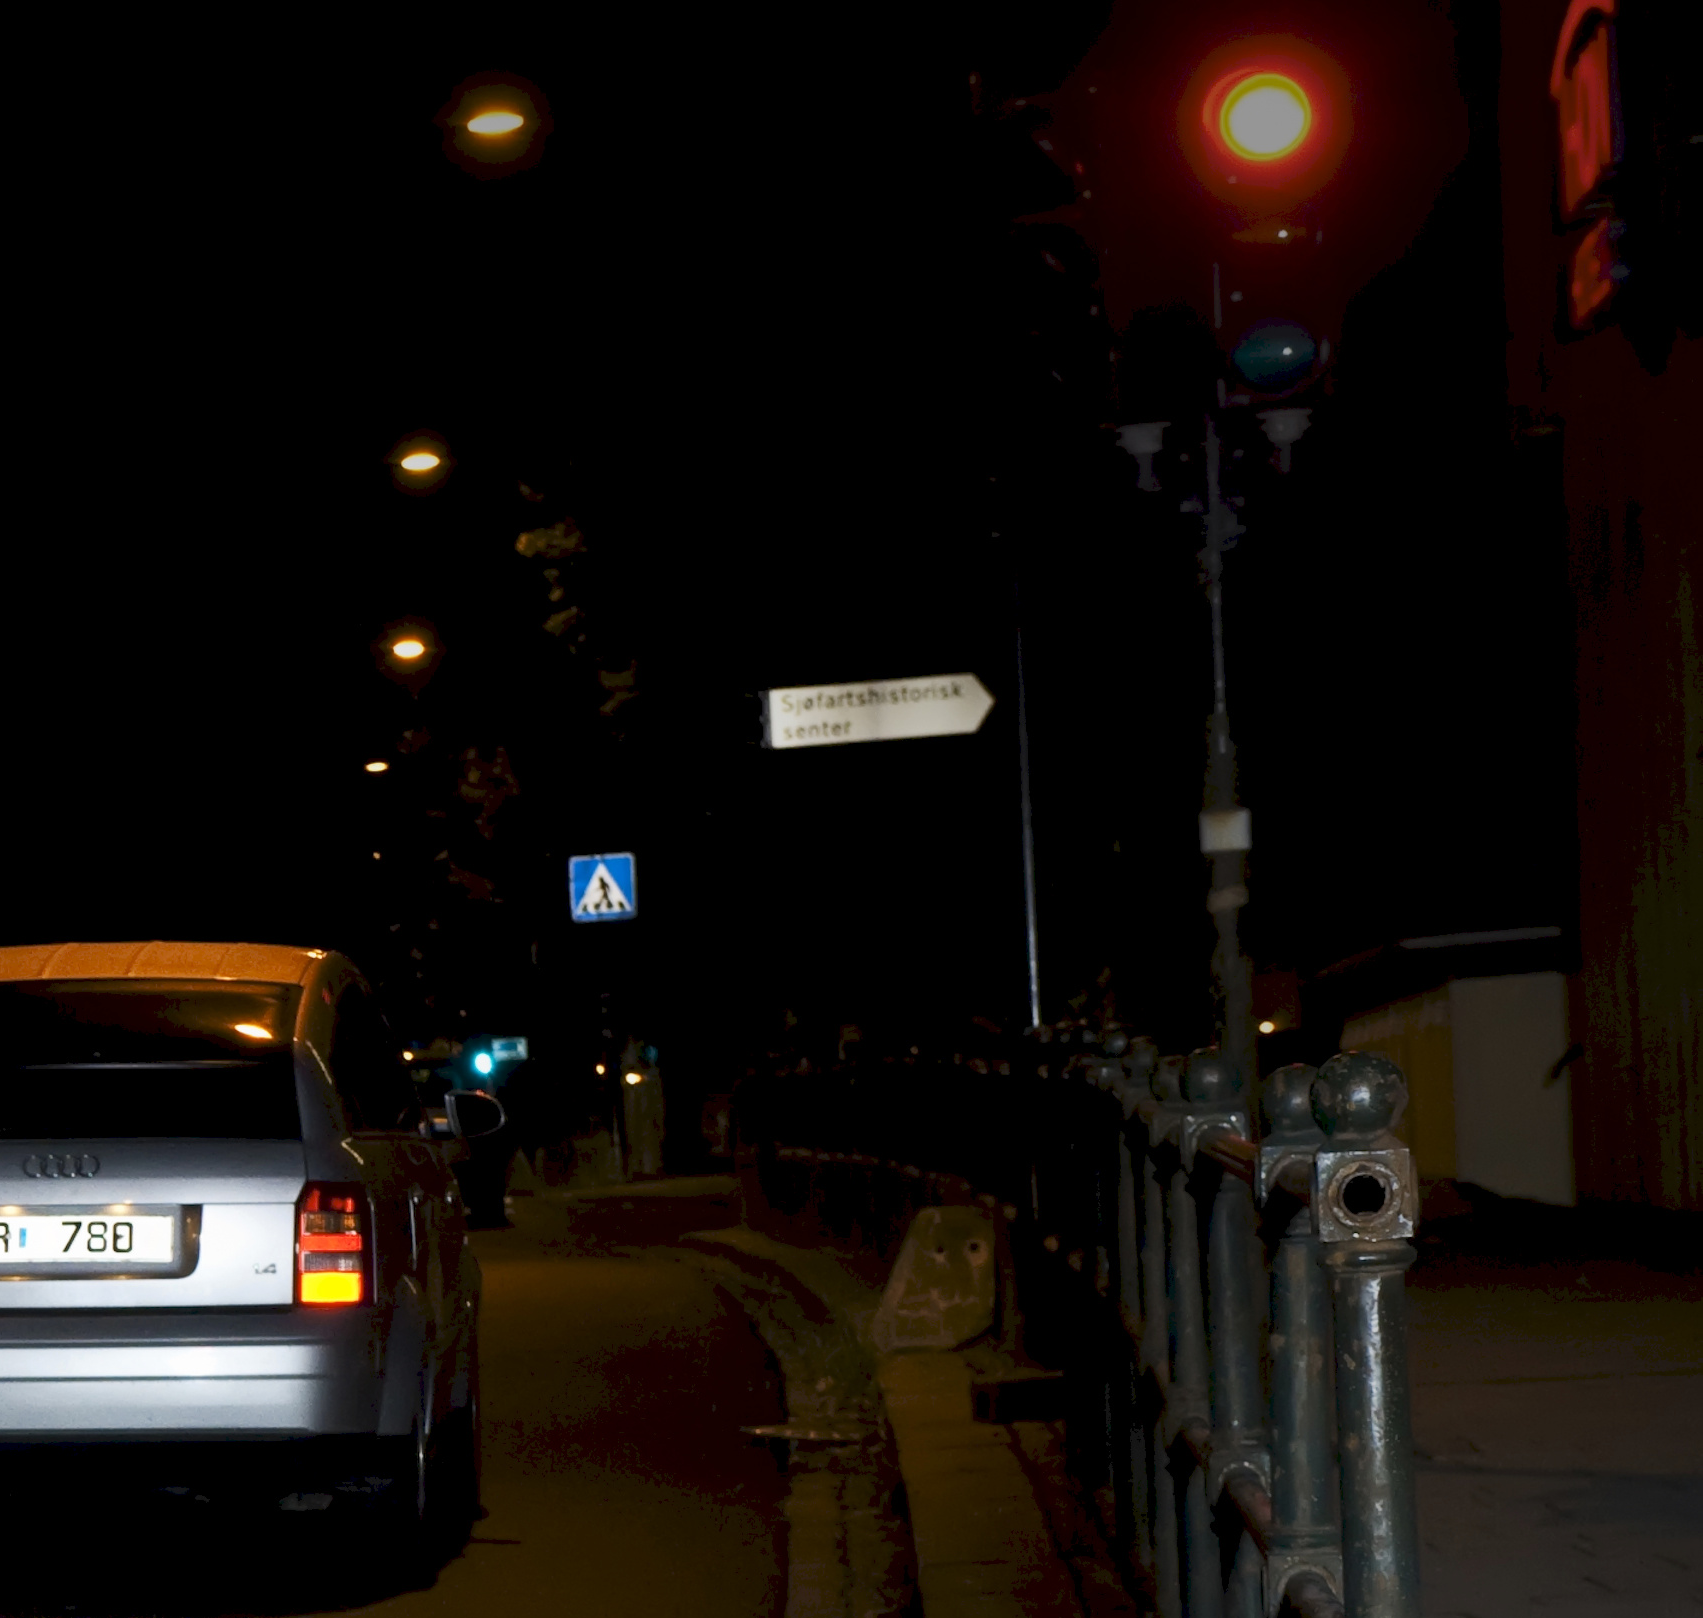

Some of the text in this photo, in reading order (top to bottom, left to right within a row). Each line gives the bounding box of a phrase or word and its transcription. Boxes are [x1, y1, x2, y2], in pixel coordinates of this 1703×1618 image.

[780, 681, 964, 716] Sjøfartshistorisk
[782, 721, 853, 740] senter
[62, 1222, 133, 1253] 780
